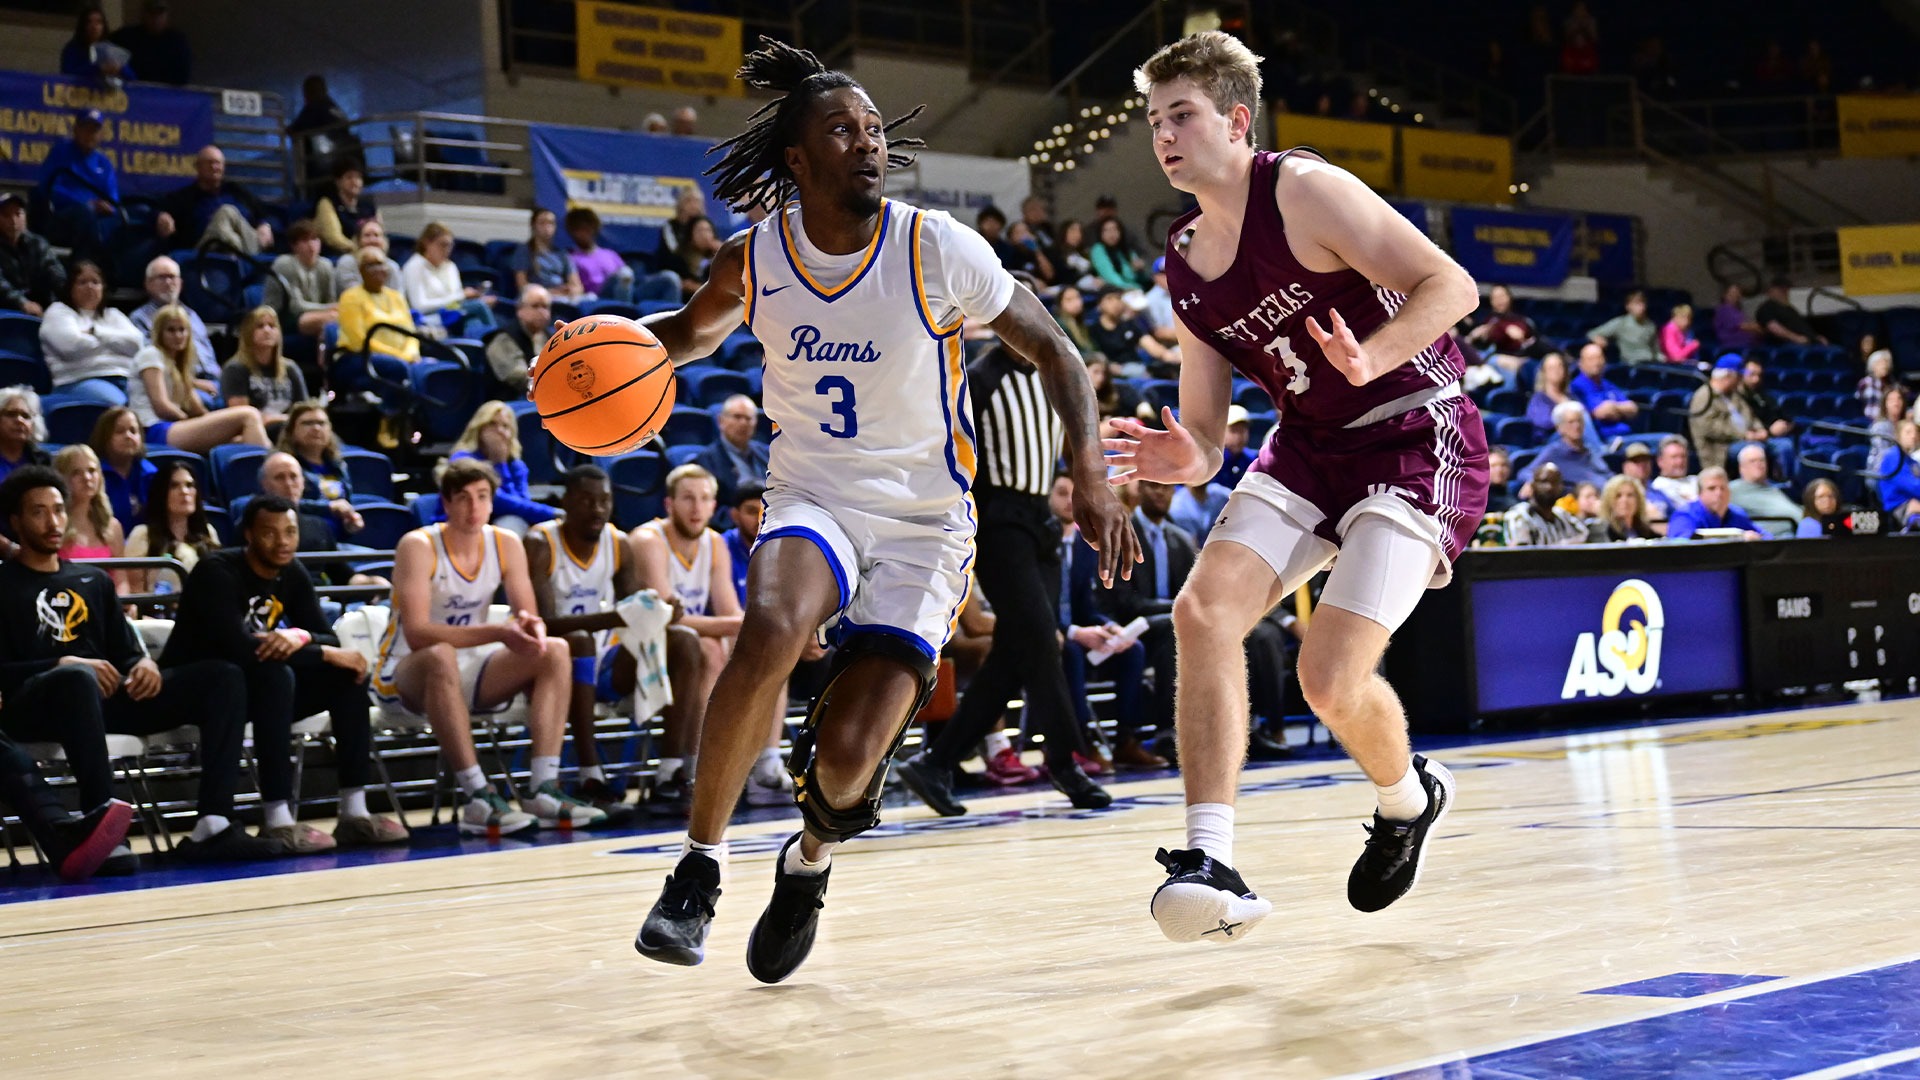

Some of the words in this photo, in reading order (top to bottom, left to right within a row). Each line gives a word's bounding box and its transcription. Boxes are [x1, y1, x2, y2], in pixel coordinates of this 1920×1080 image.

[122, 151, 198, 177] LEGRAN
[1247, 282, 1314, 332] TEXAS
[786, 324, 881, 362] Rams
[815, 375, 858, 439] 3
[1777, 597, 1811, 618] RAMS
[1561, 579, 1664, 699] ASU
